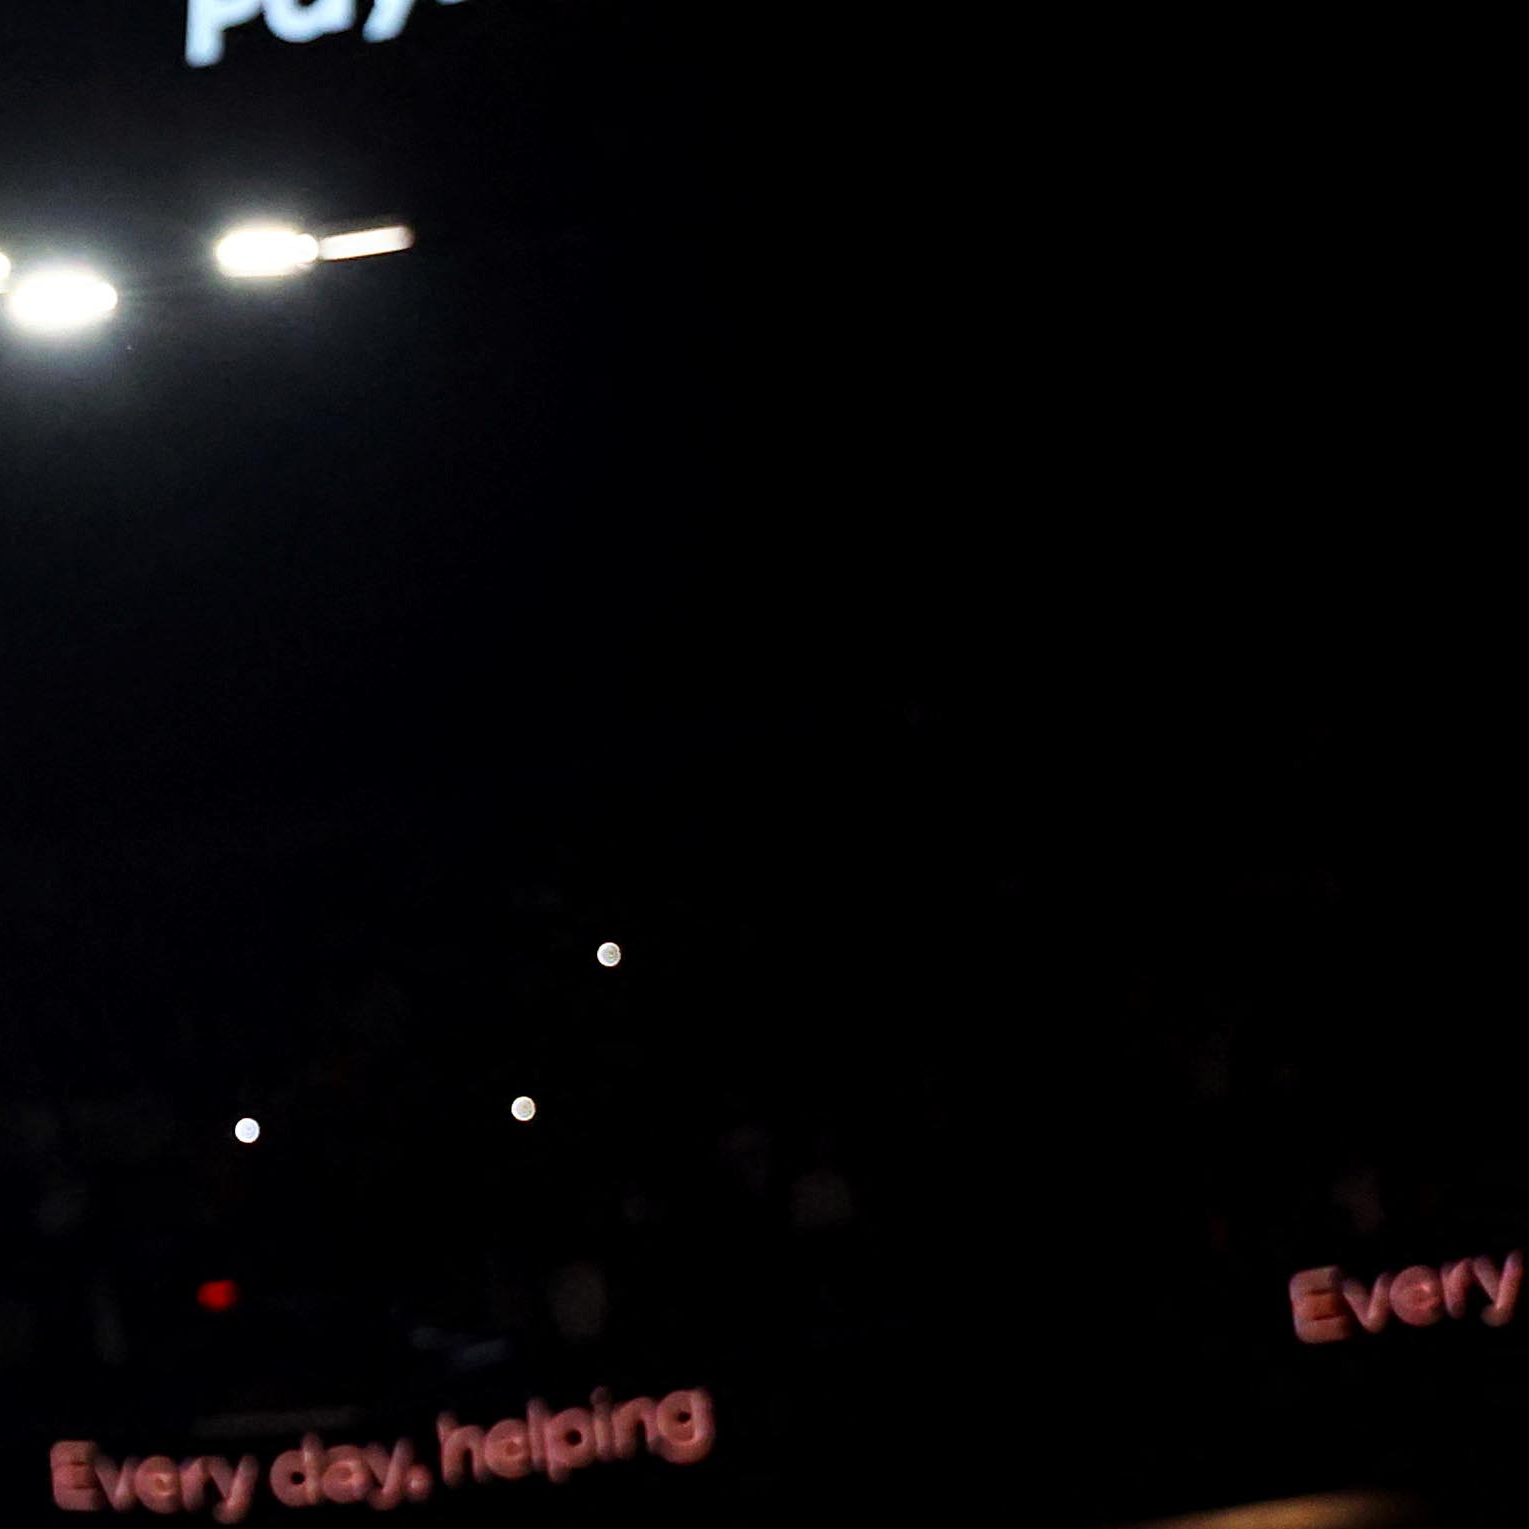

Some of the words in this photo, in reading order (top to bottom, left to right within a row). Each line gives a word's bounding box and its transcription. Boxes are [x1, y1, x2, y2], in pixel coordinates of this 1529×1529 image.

[1289, 1249, 1523, 1344] Every
[50, 1440, 259, 1525] Every
[270, 1434, 433, 1511] day,
[439, 1388, 714, 1487] helping
